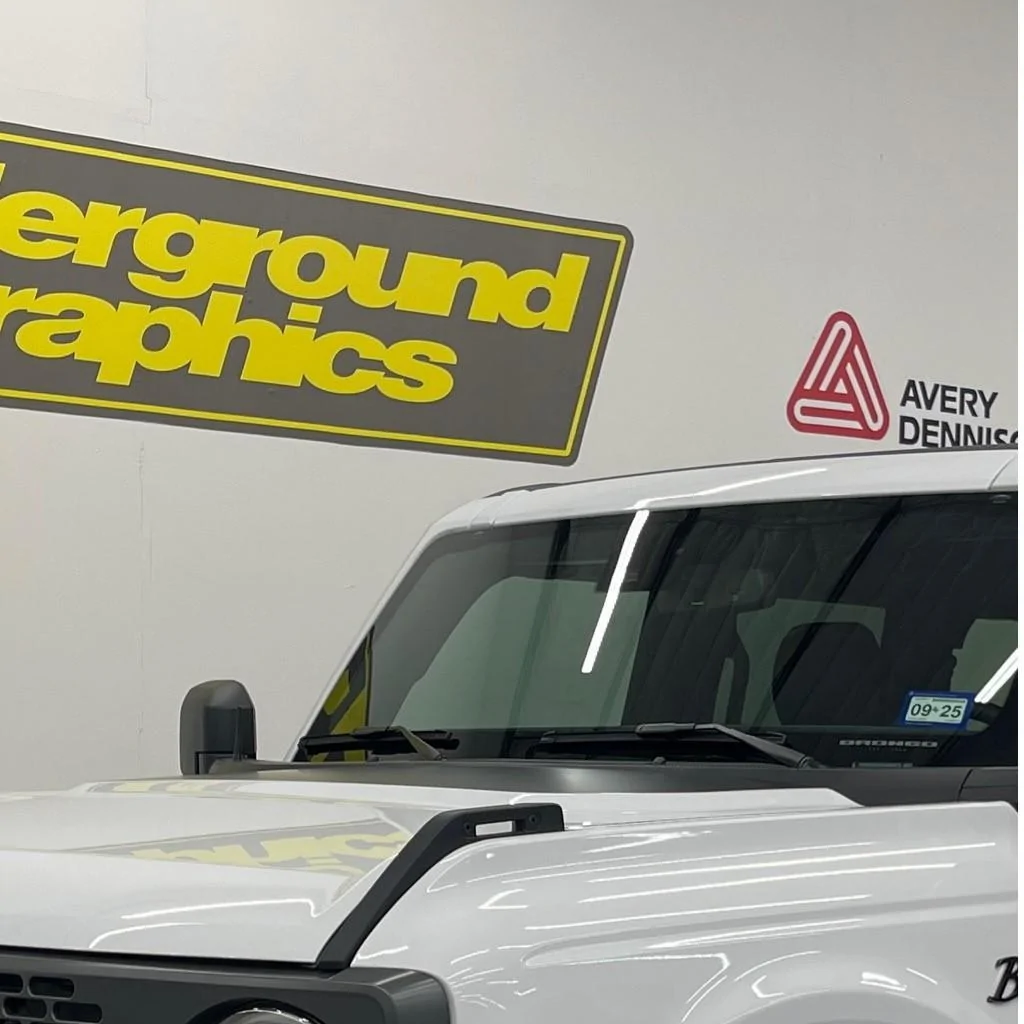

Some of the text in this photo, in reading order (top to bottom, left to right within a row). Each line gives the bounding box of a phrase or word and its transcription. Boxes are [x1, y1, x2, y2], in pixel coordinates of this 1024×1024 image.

[0, 163, 590, 333] erground
[900, 379, 998, 419] AVERY
[899, 415, 1018, 449] DENNIS
[910, 703, 962, 718] 09 25
